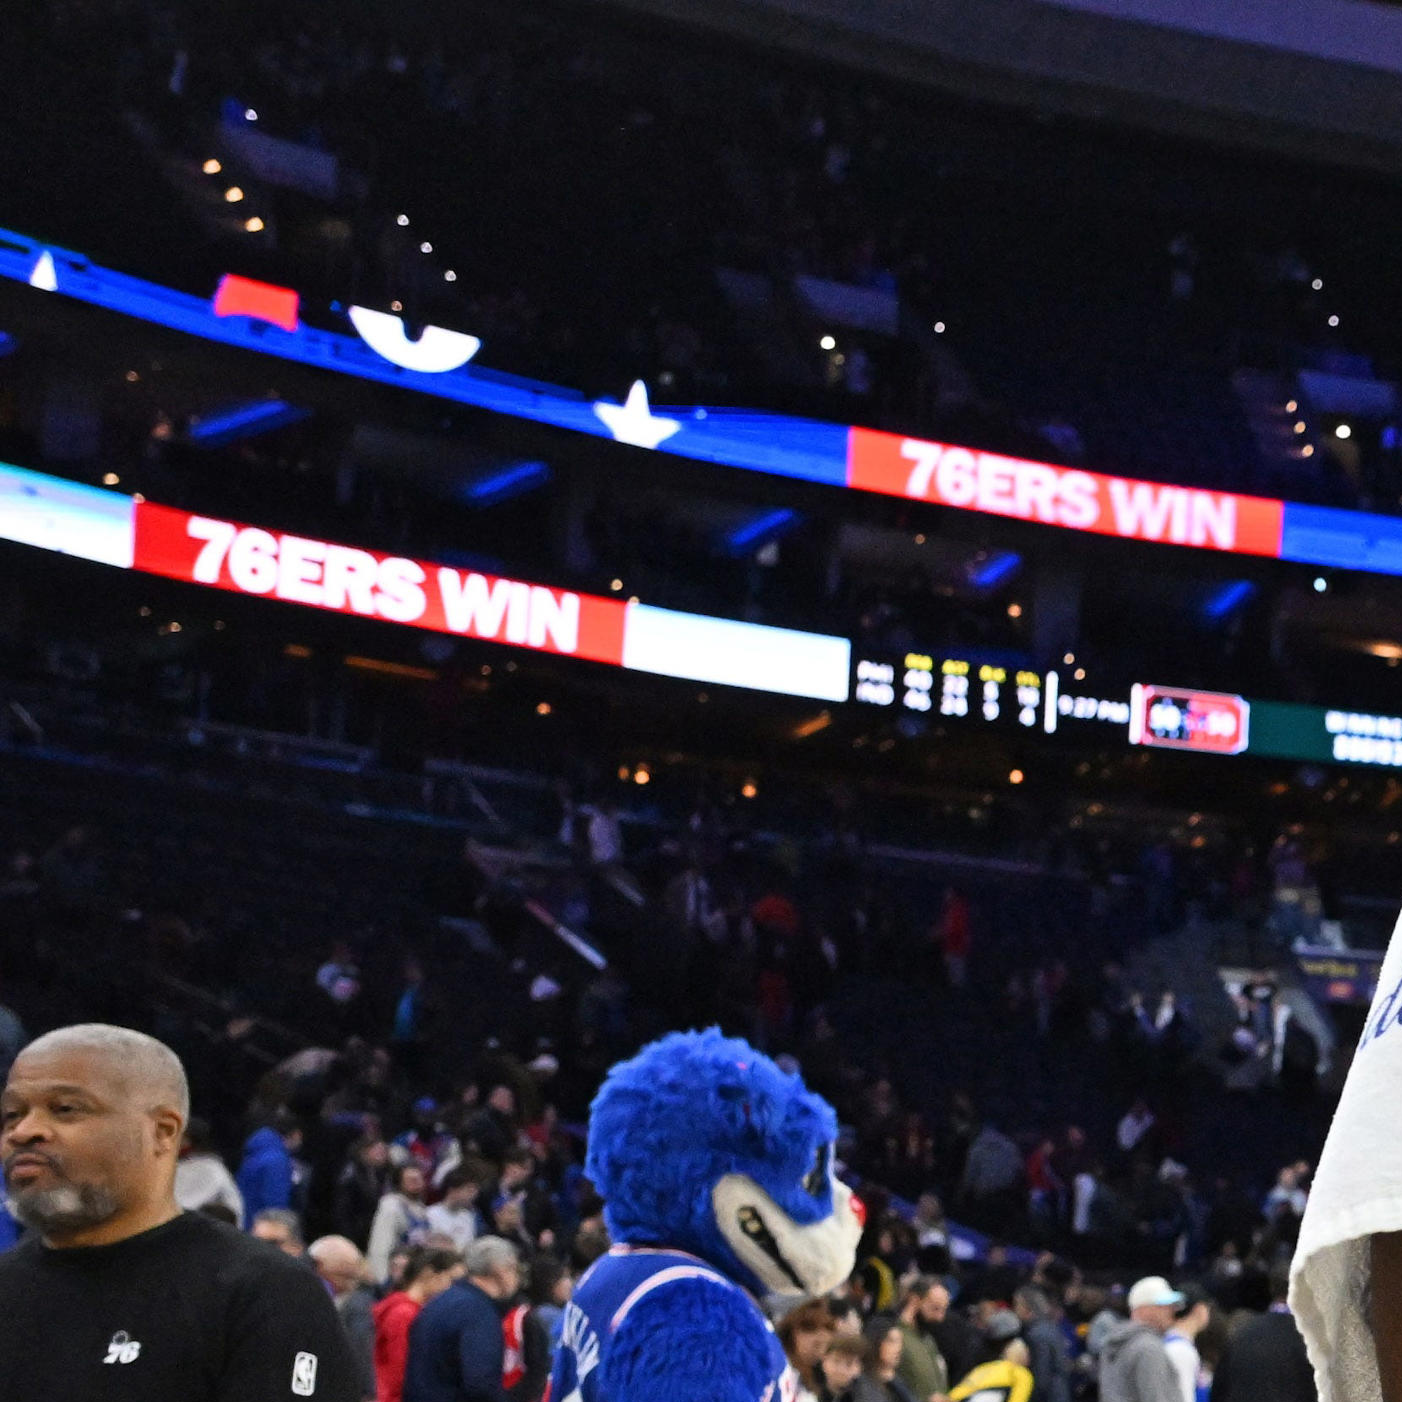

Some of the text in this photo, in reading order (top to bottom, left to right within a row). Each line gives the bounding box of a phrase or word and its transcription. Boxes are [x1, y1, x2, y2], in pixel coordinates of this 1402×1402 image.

[900, 438, 1236, 550] 76ERS WIN
[187, 515, 580, 653] 76ERS WIN
